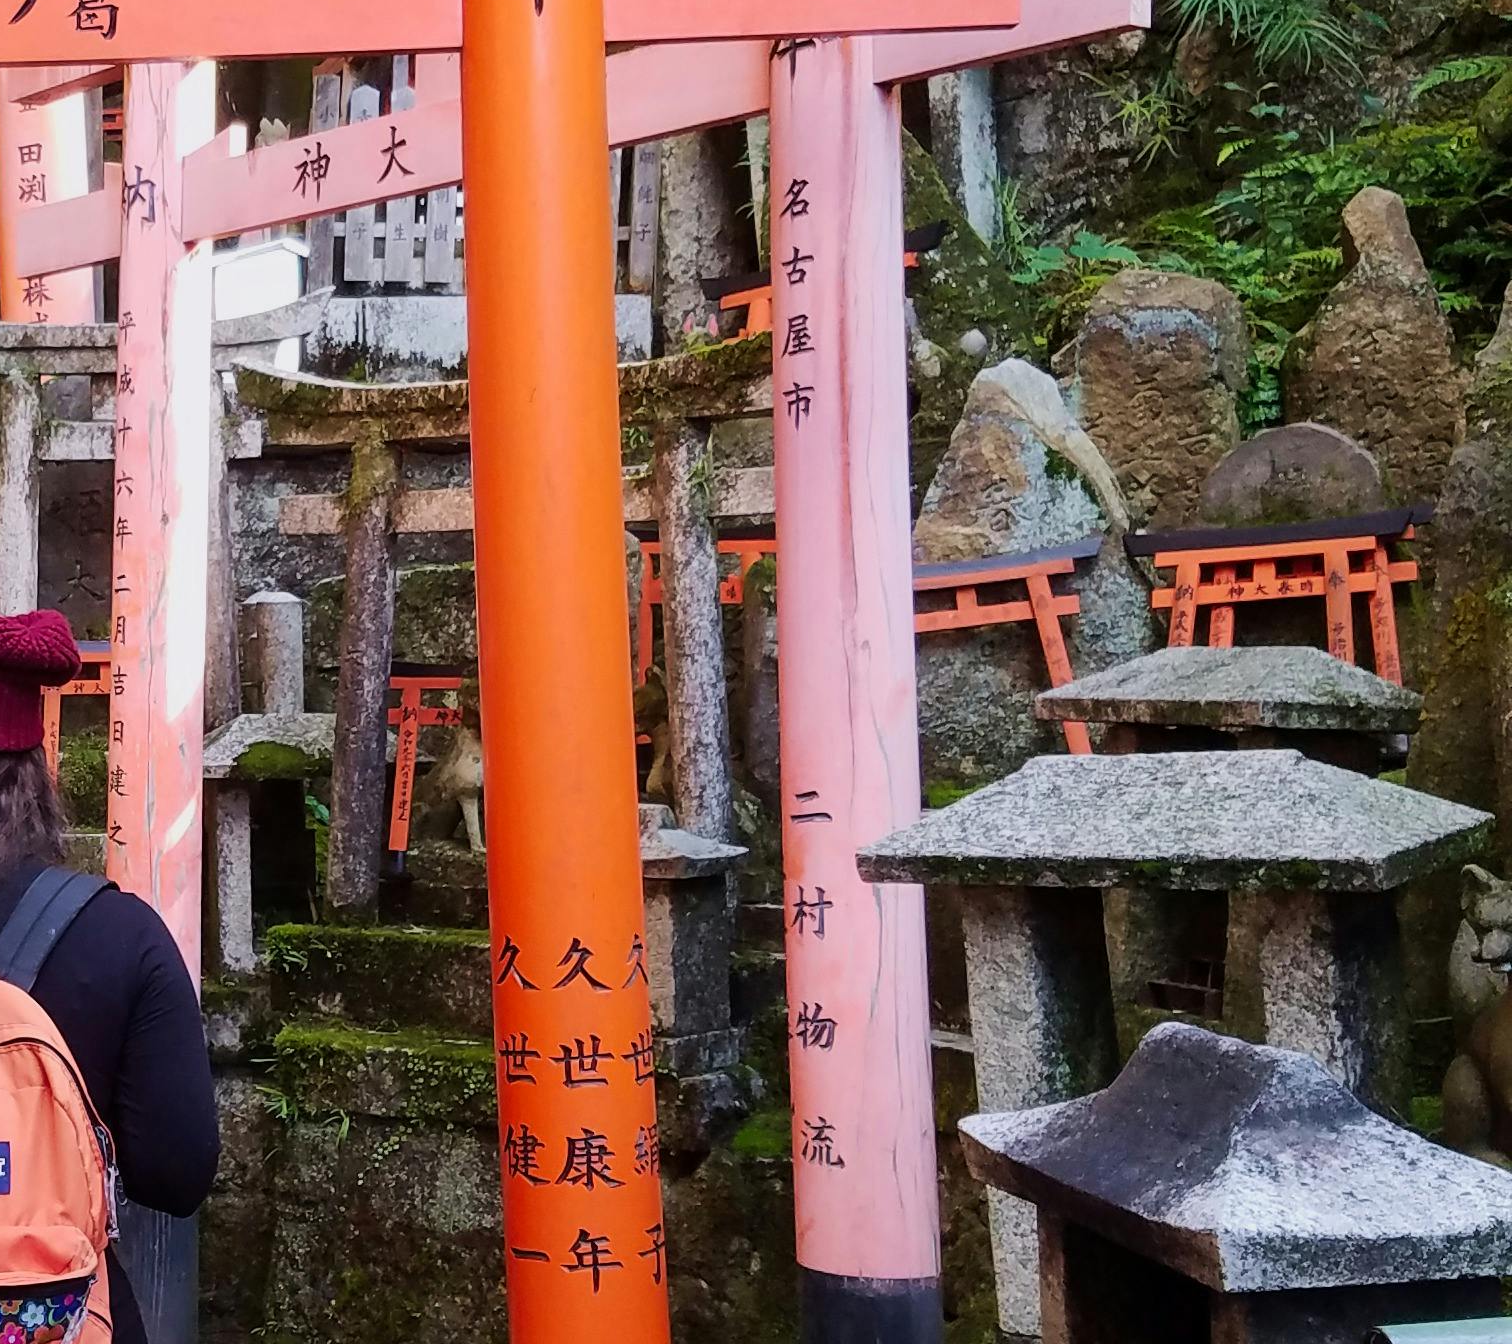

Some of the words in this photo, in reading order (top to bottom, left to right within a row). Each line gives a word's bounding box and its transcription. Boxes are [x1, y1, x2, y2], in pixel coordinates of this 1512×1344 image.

[780, 178, 815, 432] 名古屋市
[106, 309, 137, 848] 平成十六年二月吉日建之
[548, 938, 626, 1294] 久世康年
[790, 790, 845, 1169] 二村物流
